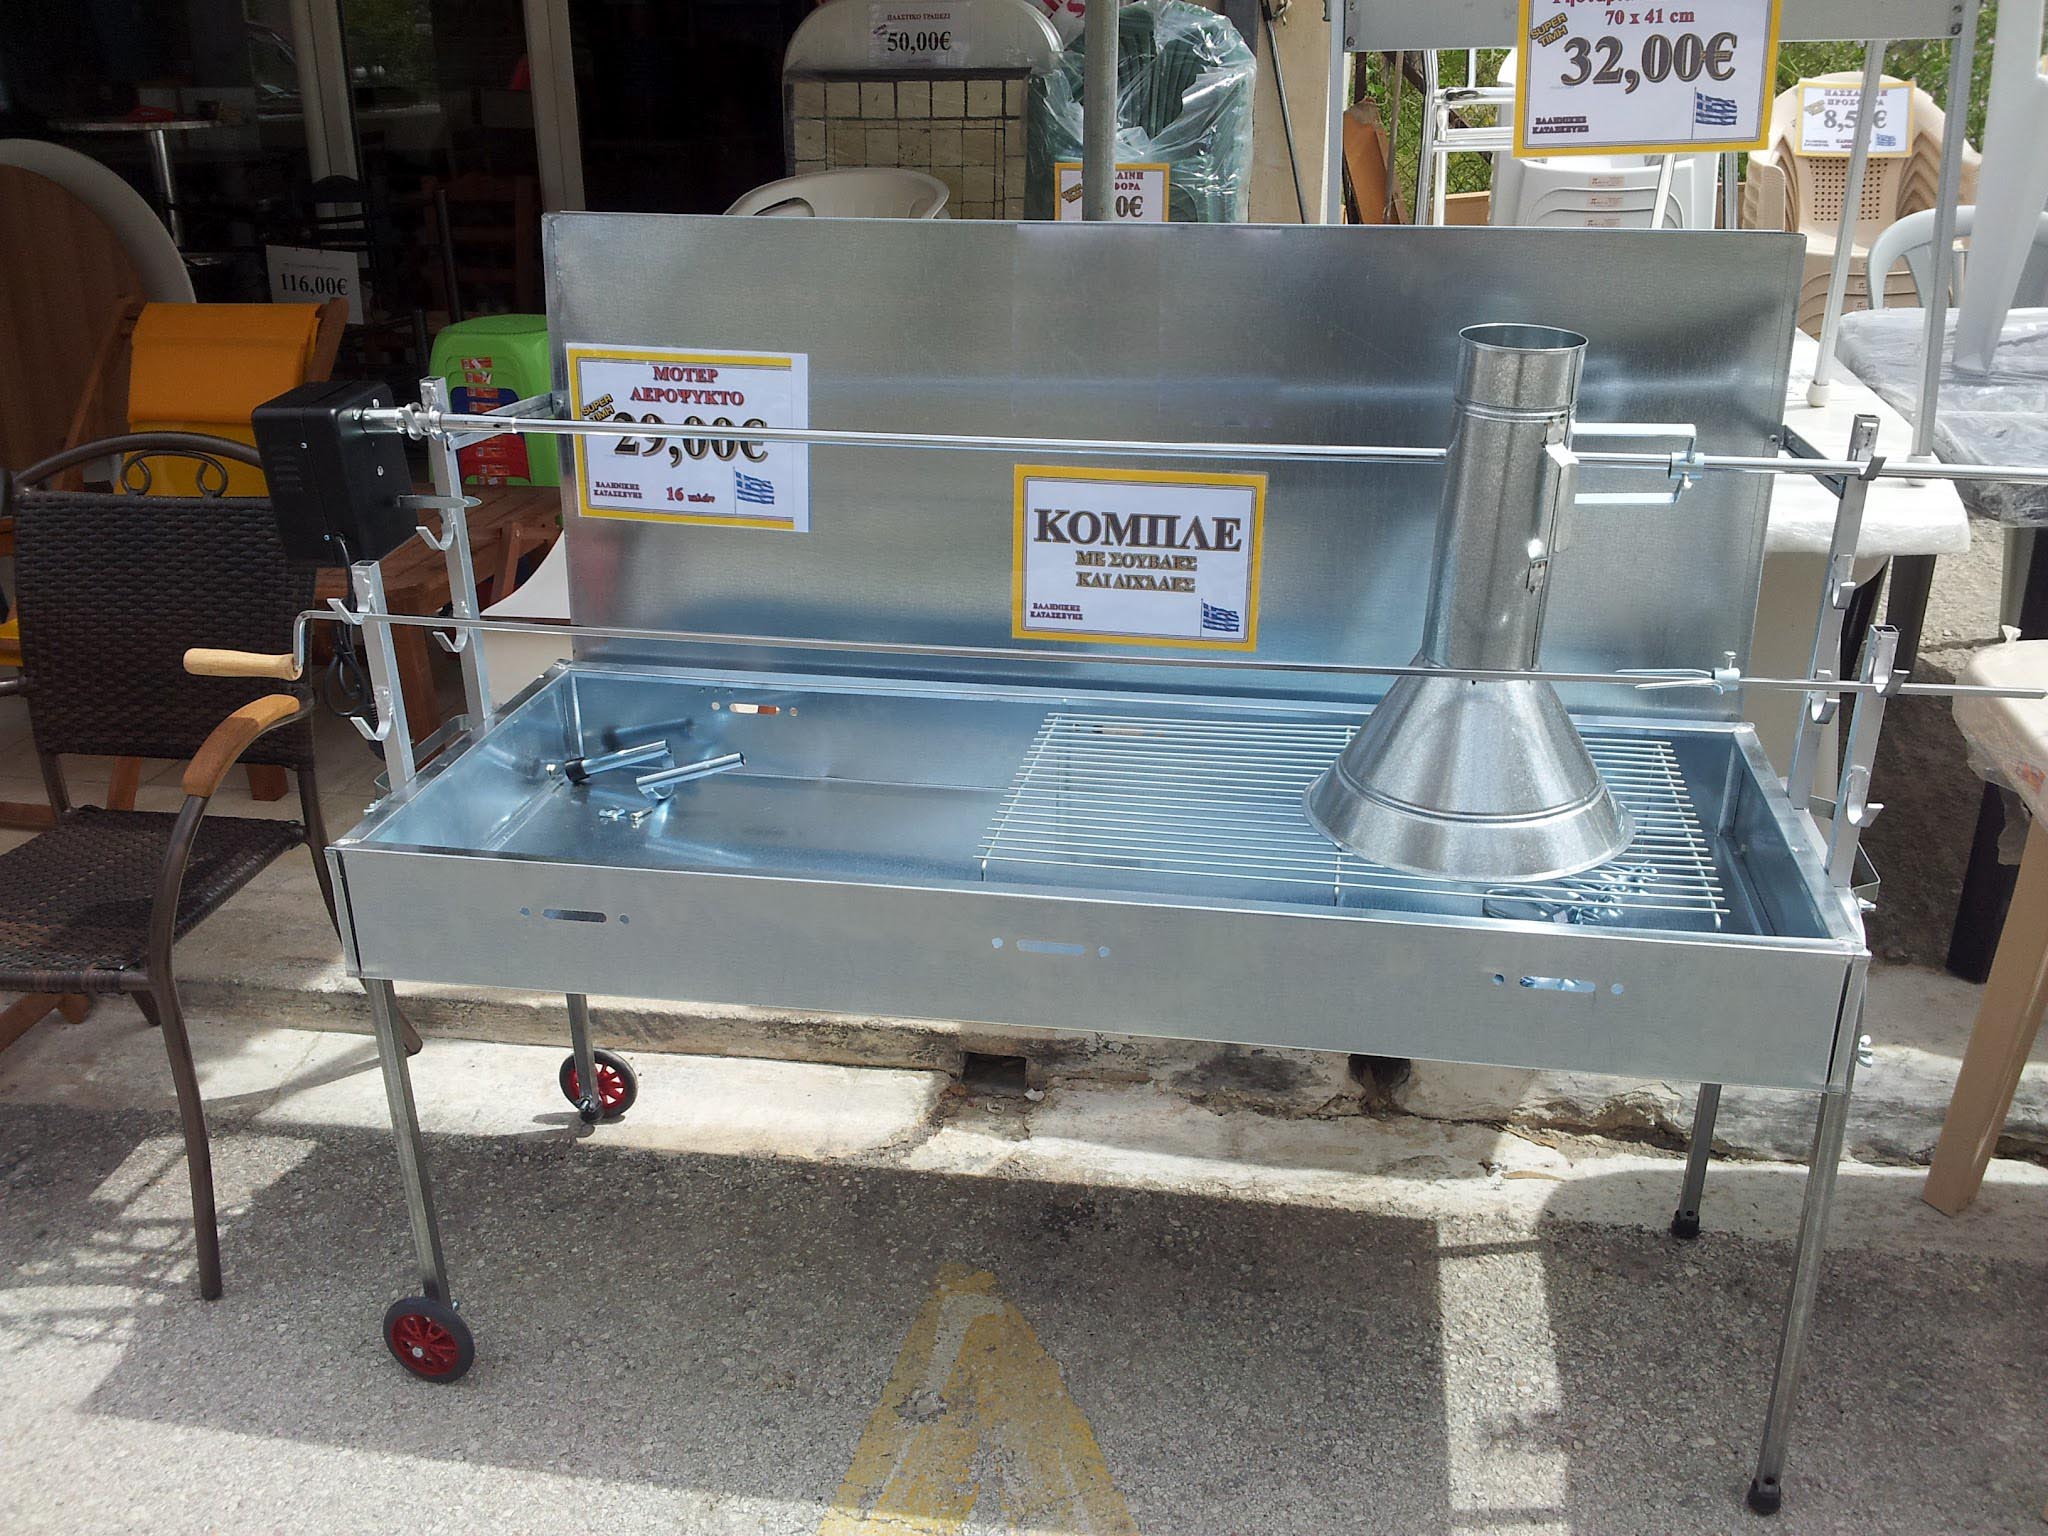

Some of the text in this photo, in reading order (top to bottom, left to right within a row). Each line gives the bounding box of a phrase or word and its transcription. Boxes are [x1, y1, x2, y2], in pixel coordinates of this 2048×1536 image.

[1530, 12, 1568, 40] SUPER
[1604, 8, 1695, 26] 70 x 41 cm
[886, 30, 952, 55] 50,00€
[1560, 31, 1738, 95] 32,00€
[1824, 109, 1888, 133] 8,5€
[281, 273, 349, 296] 116,00€
[652, 365, 719, 384] ΜΟΤΕΡ
[581, 393, 614, 417] SUPER
[629, 386, 745, 407] ΑΕΡΟΨΥΚΤΟ
[613, 411, 769, 468] 29,00€
[666, 486, 685, 502] 16
[1033, 508, 1242, 552] ΚΟΜΠΛΕ
[1075, 550, 1198, 572] ΜΕ ΣΟΥΒΛΕΣ
[1075, 571, 1196, 593] ΚΑΙ ΔΙΧΑΛΕΣ
